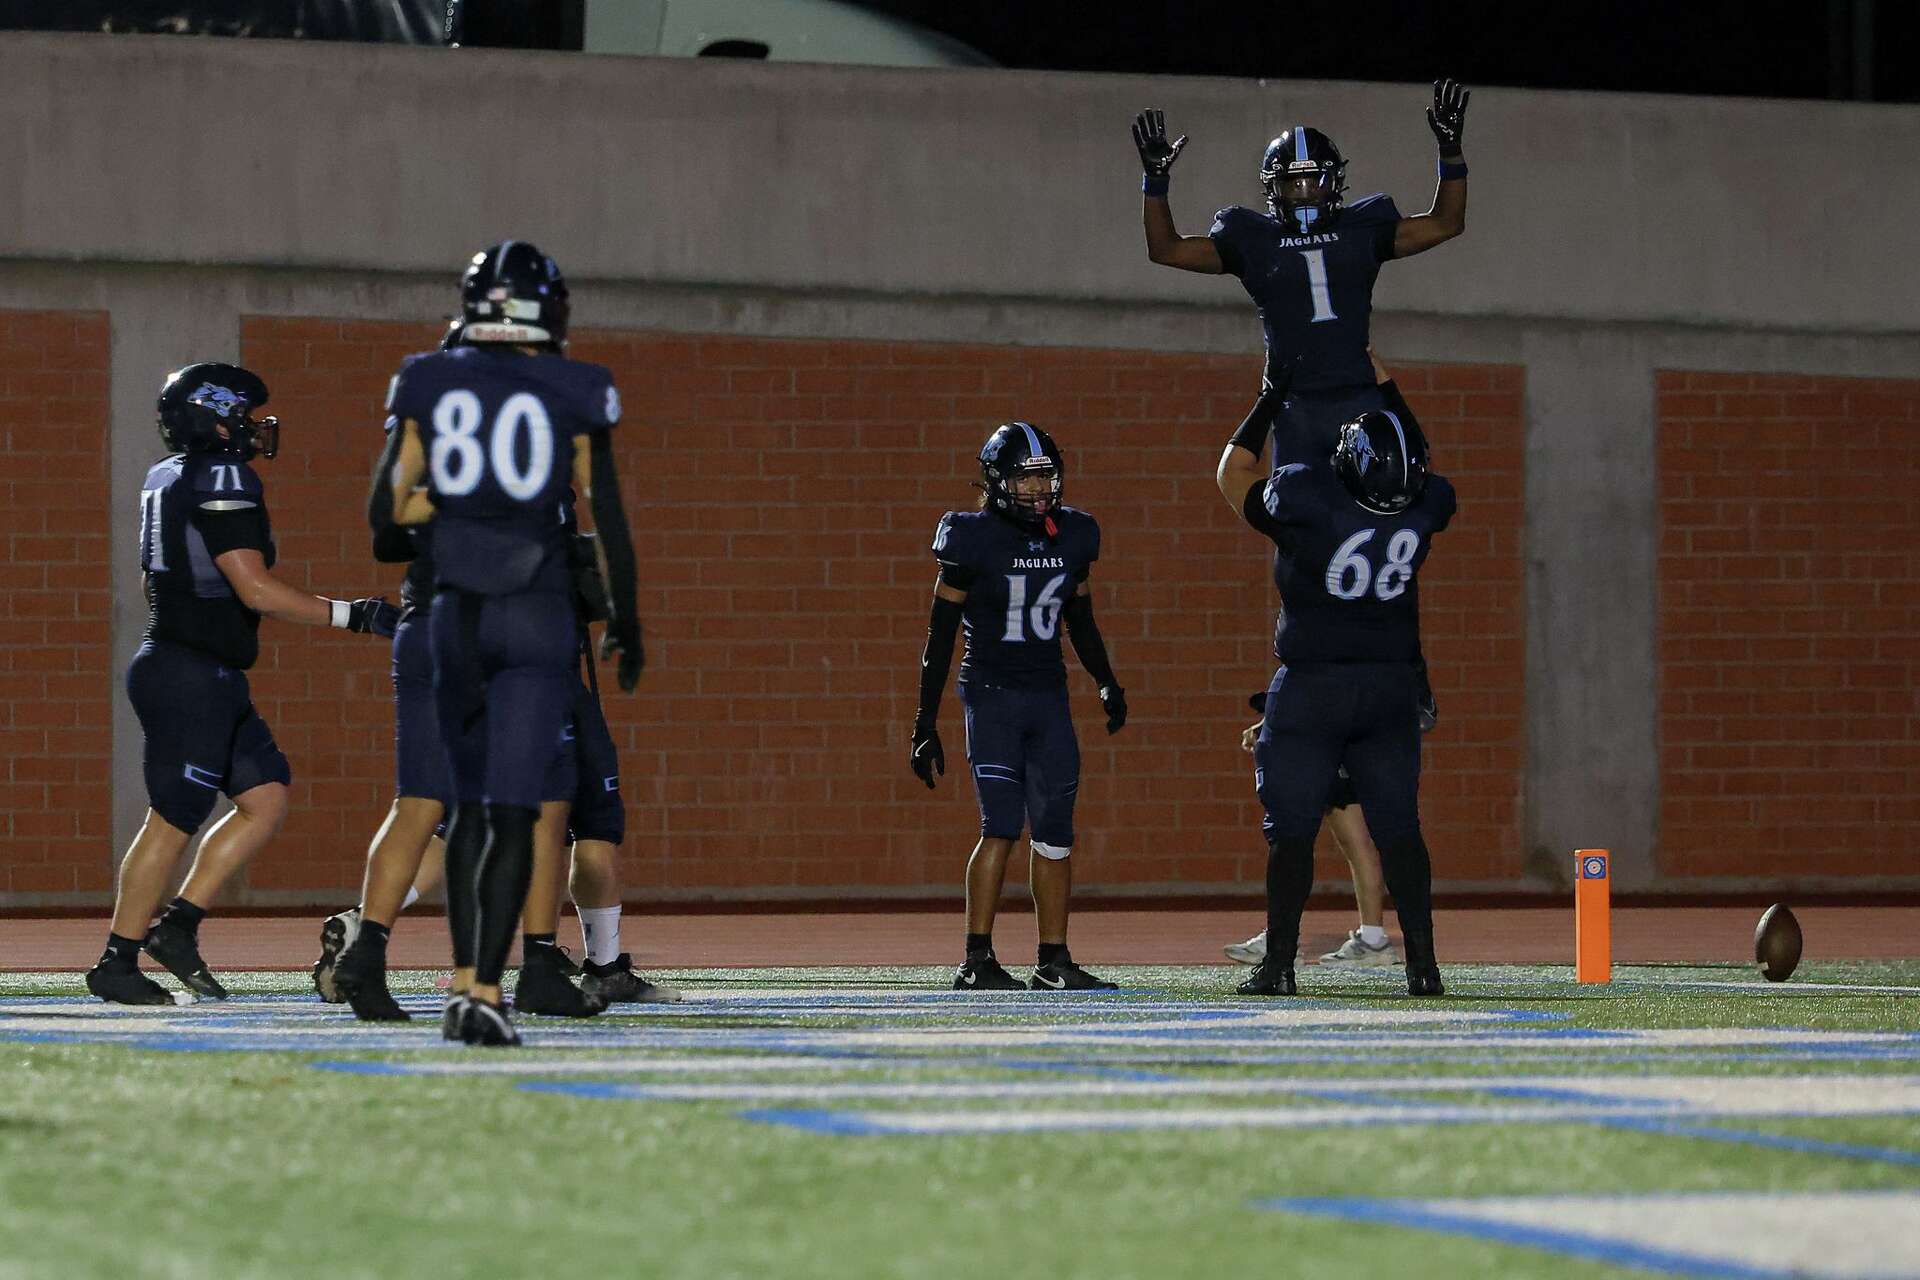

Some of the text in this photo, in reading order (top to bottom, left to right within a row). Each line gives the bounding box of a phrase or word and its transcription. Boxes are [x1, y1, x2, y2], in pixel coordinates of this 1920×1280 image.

[1279, 232, 1340, 248] JAGUARS
[1299, 248, 1339, 323] 1
[210, 464, 245, 492] 71
[430, 388, 554, 501] 80
[1012, 557, 1064, 569] JAGUARS
[1325, 528, 1420, 601] 68
[1001, 573, 1067, 643] 16
